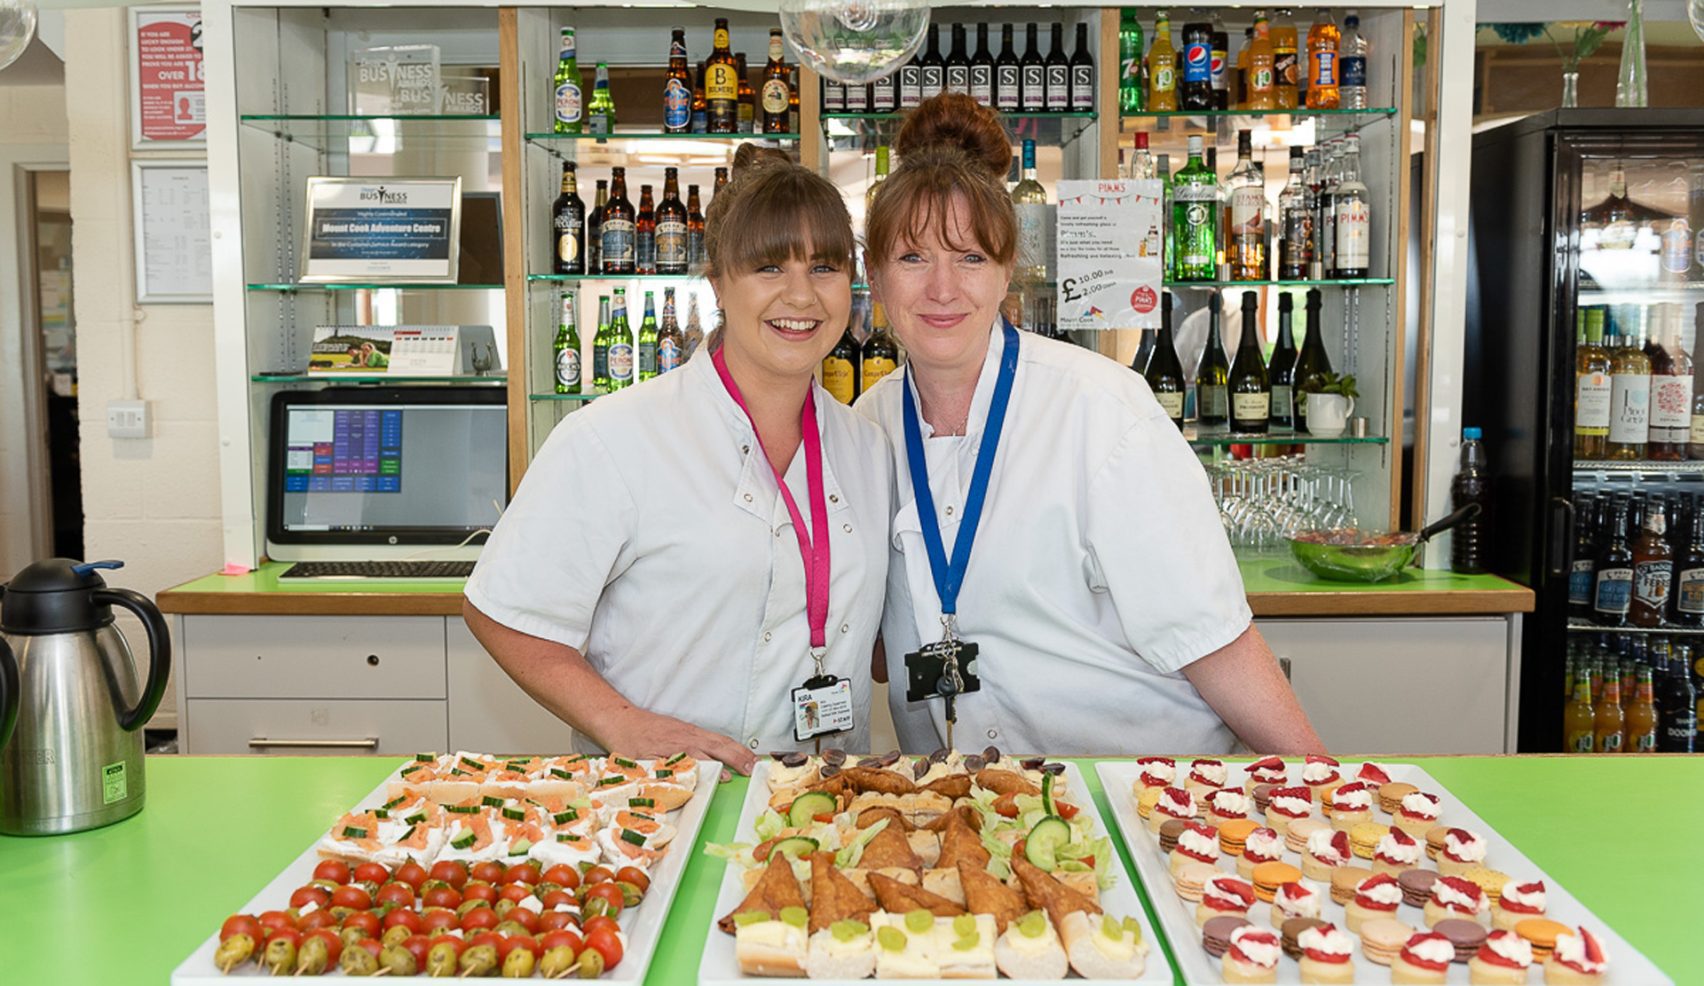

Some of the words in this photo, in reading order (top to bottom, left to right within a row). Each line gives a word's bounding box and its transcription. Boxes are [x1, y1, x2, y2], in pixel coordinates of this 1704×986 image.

[158, 71, 184, 80] OVER
[715, 67, 727, 85] B
[906, 69, 917, 85] S
[925, 69, 938, 85] S
[952, 69, 964, 85] S
[974, 69, 986, 84] S
[1002, 69, 1015, 84] S
[1028, 69, 1040, 84] S
[1052, 69, 1064, 84] S
[1078, 69, 1089, 84] S
[322, 223, 349, 233] Mount
[349, 223, 370, 233] Cook
[371, 222, 412, 233] Adventure
[413, 223, 441, 233] Centre
[1062, 278, 1082, 303] £
[1079, 269, 1103, 284] 10.00
[1082, 284, 1103, 296] 2.00
